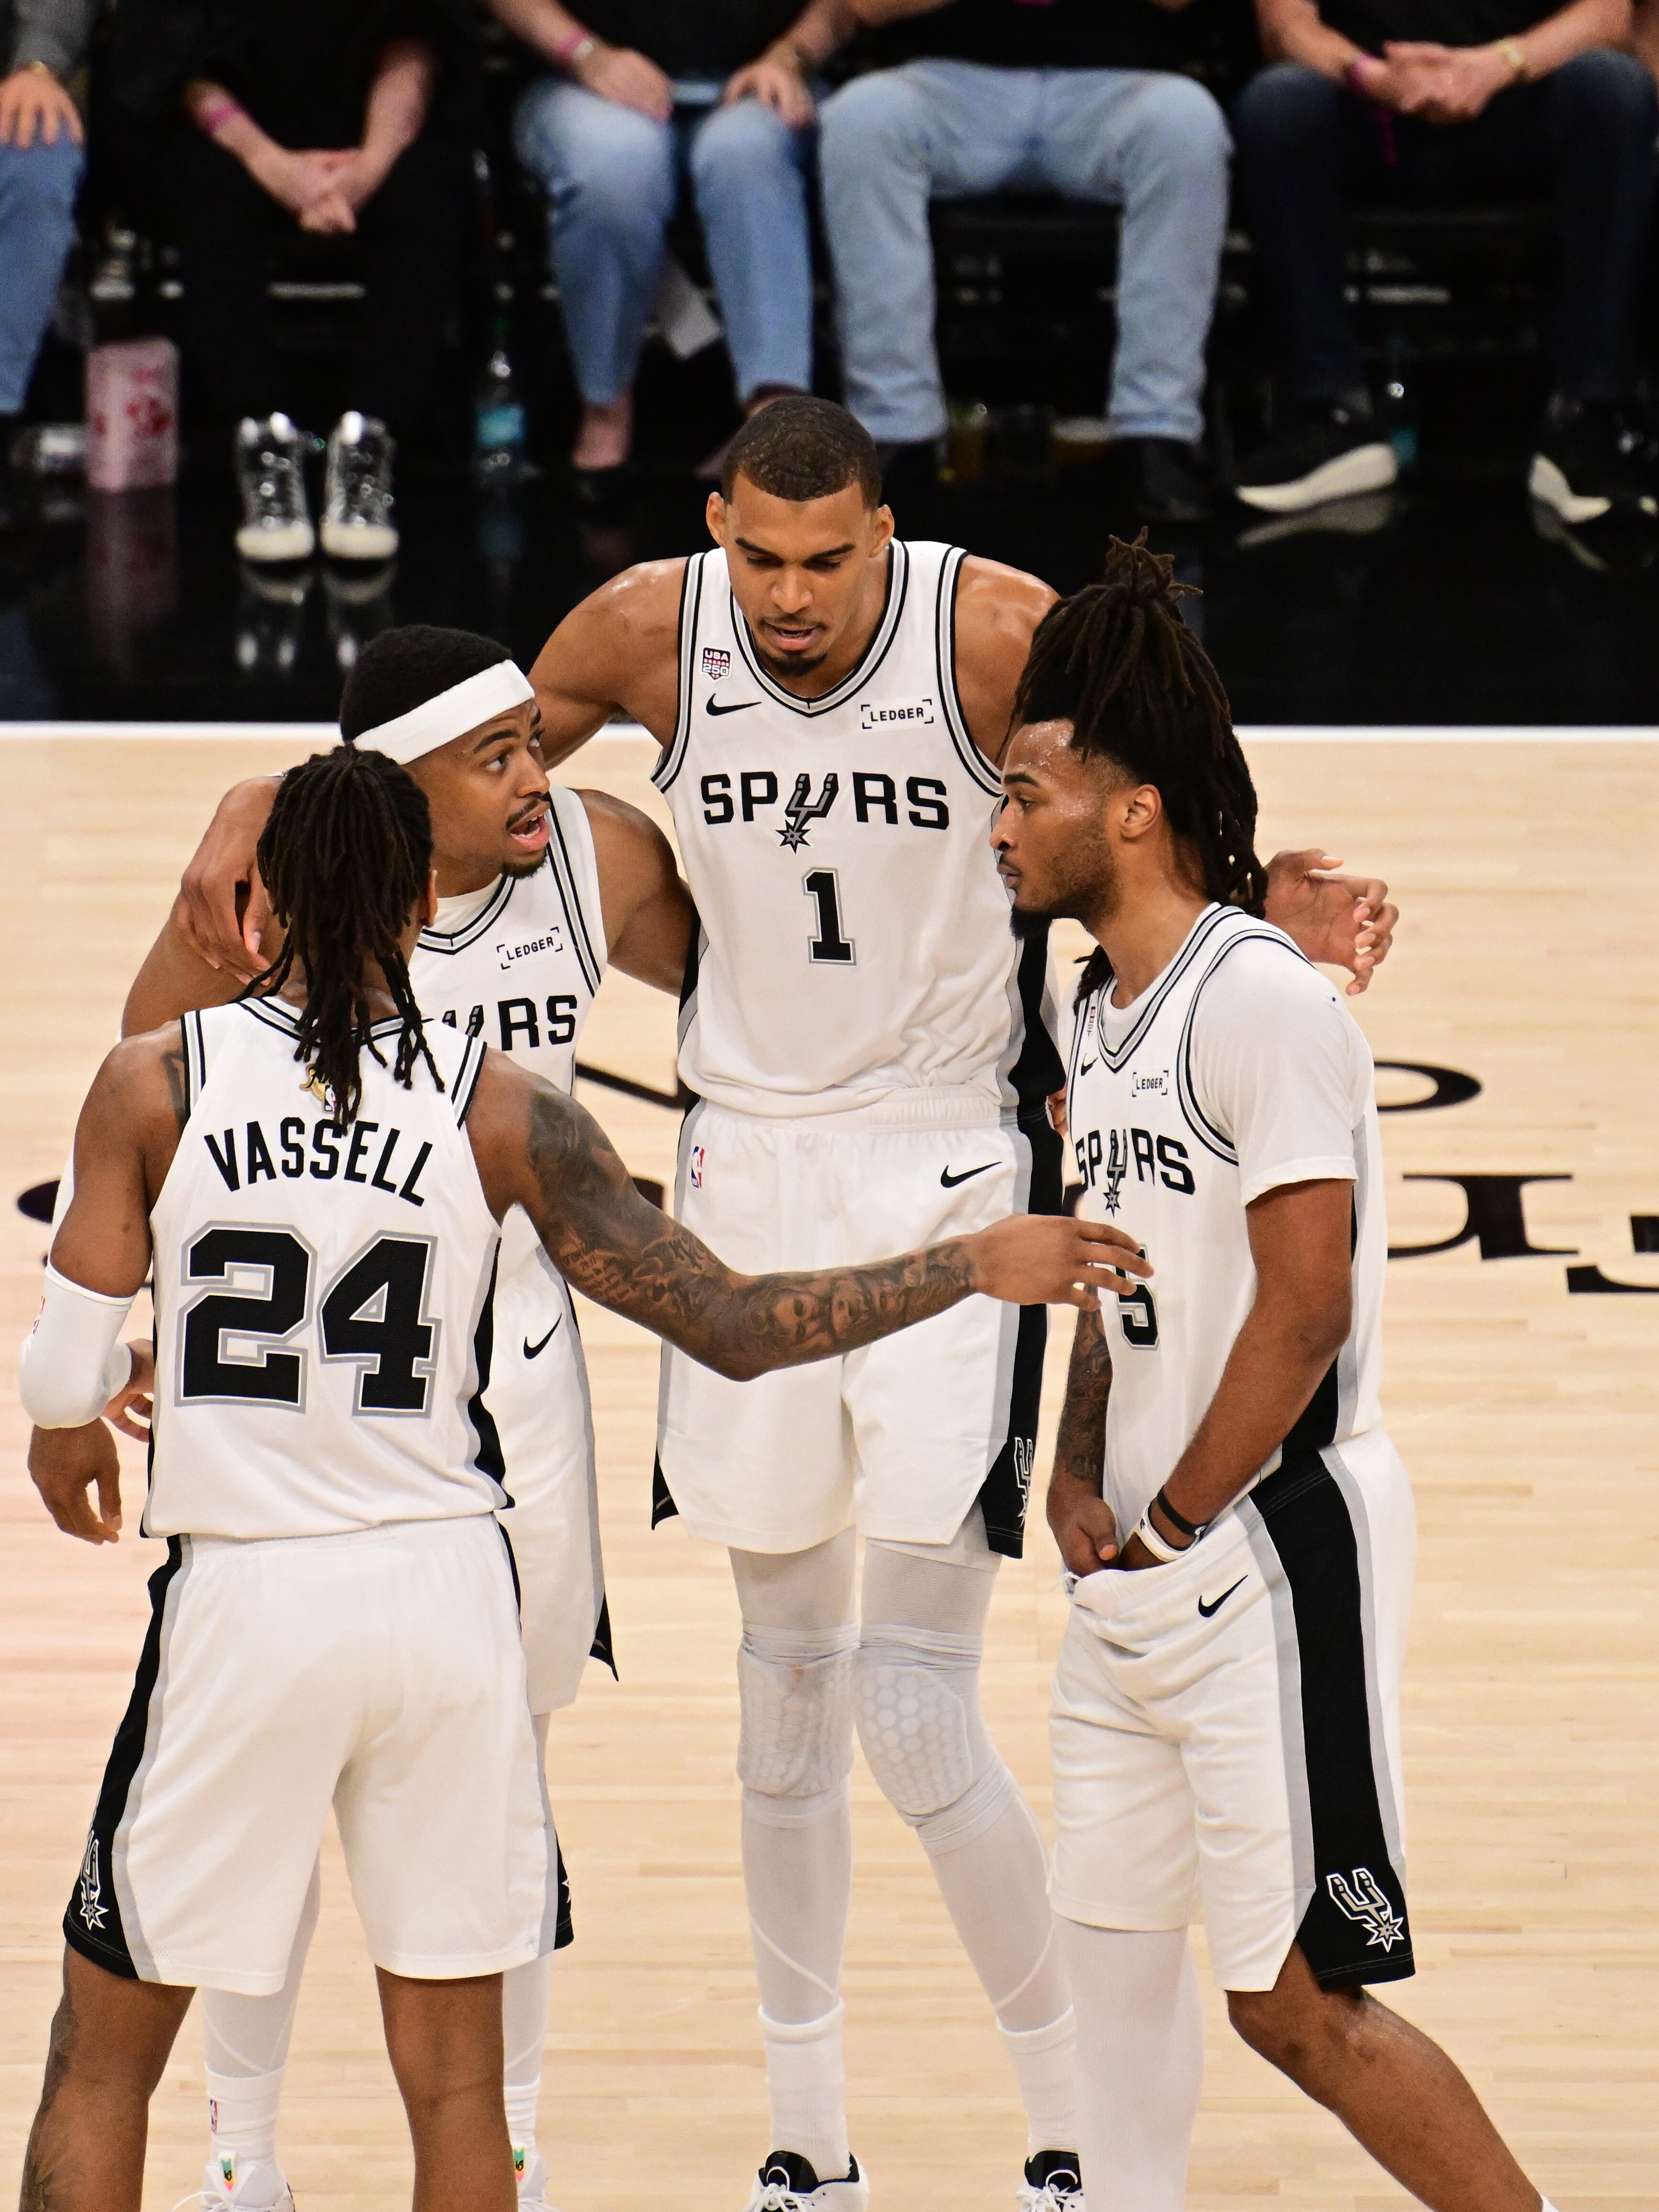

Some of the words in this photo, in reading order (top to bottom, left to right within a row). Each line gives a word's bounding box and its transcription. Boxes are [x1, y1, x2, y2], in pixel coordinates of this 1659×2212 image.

[702, 663, 729, 676] 250
[705, 650, 729, 661] USA
[870, 707, 924, 722] LEDGER
[700, 771, 950, 854] SPURS
[802, 867, 857, 966] 1
[506, 936, 554, 961] LEDGER
[1136, 1077, 1163, 1090] LEDGER
[204, 1117, 433, 1207] VASSELL
[1075, 1128, 1196, 1218] SPURS
[174, 1220, 442, 1418] 24
